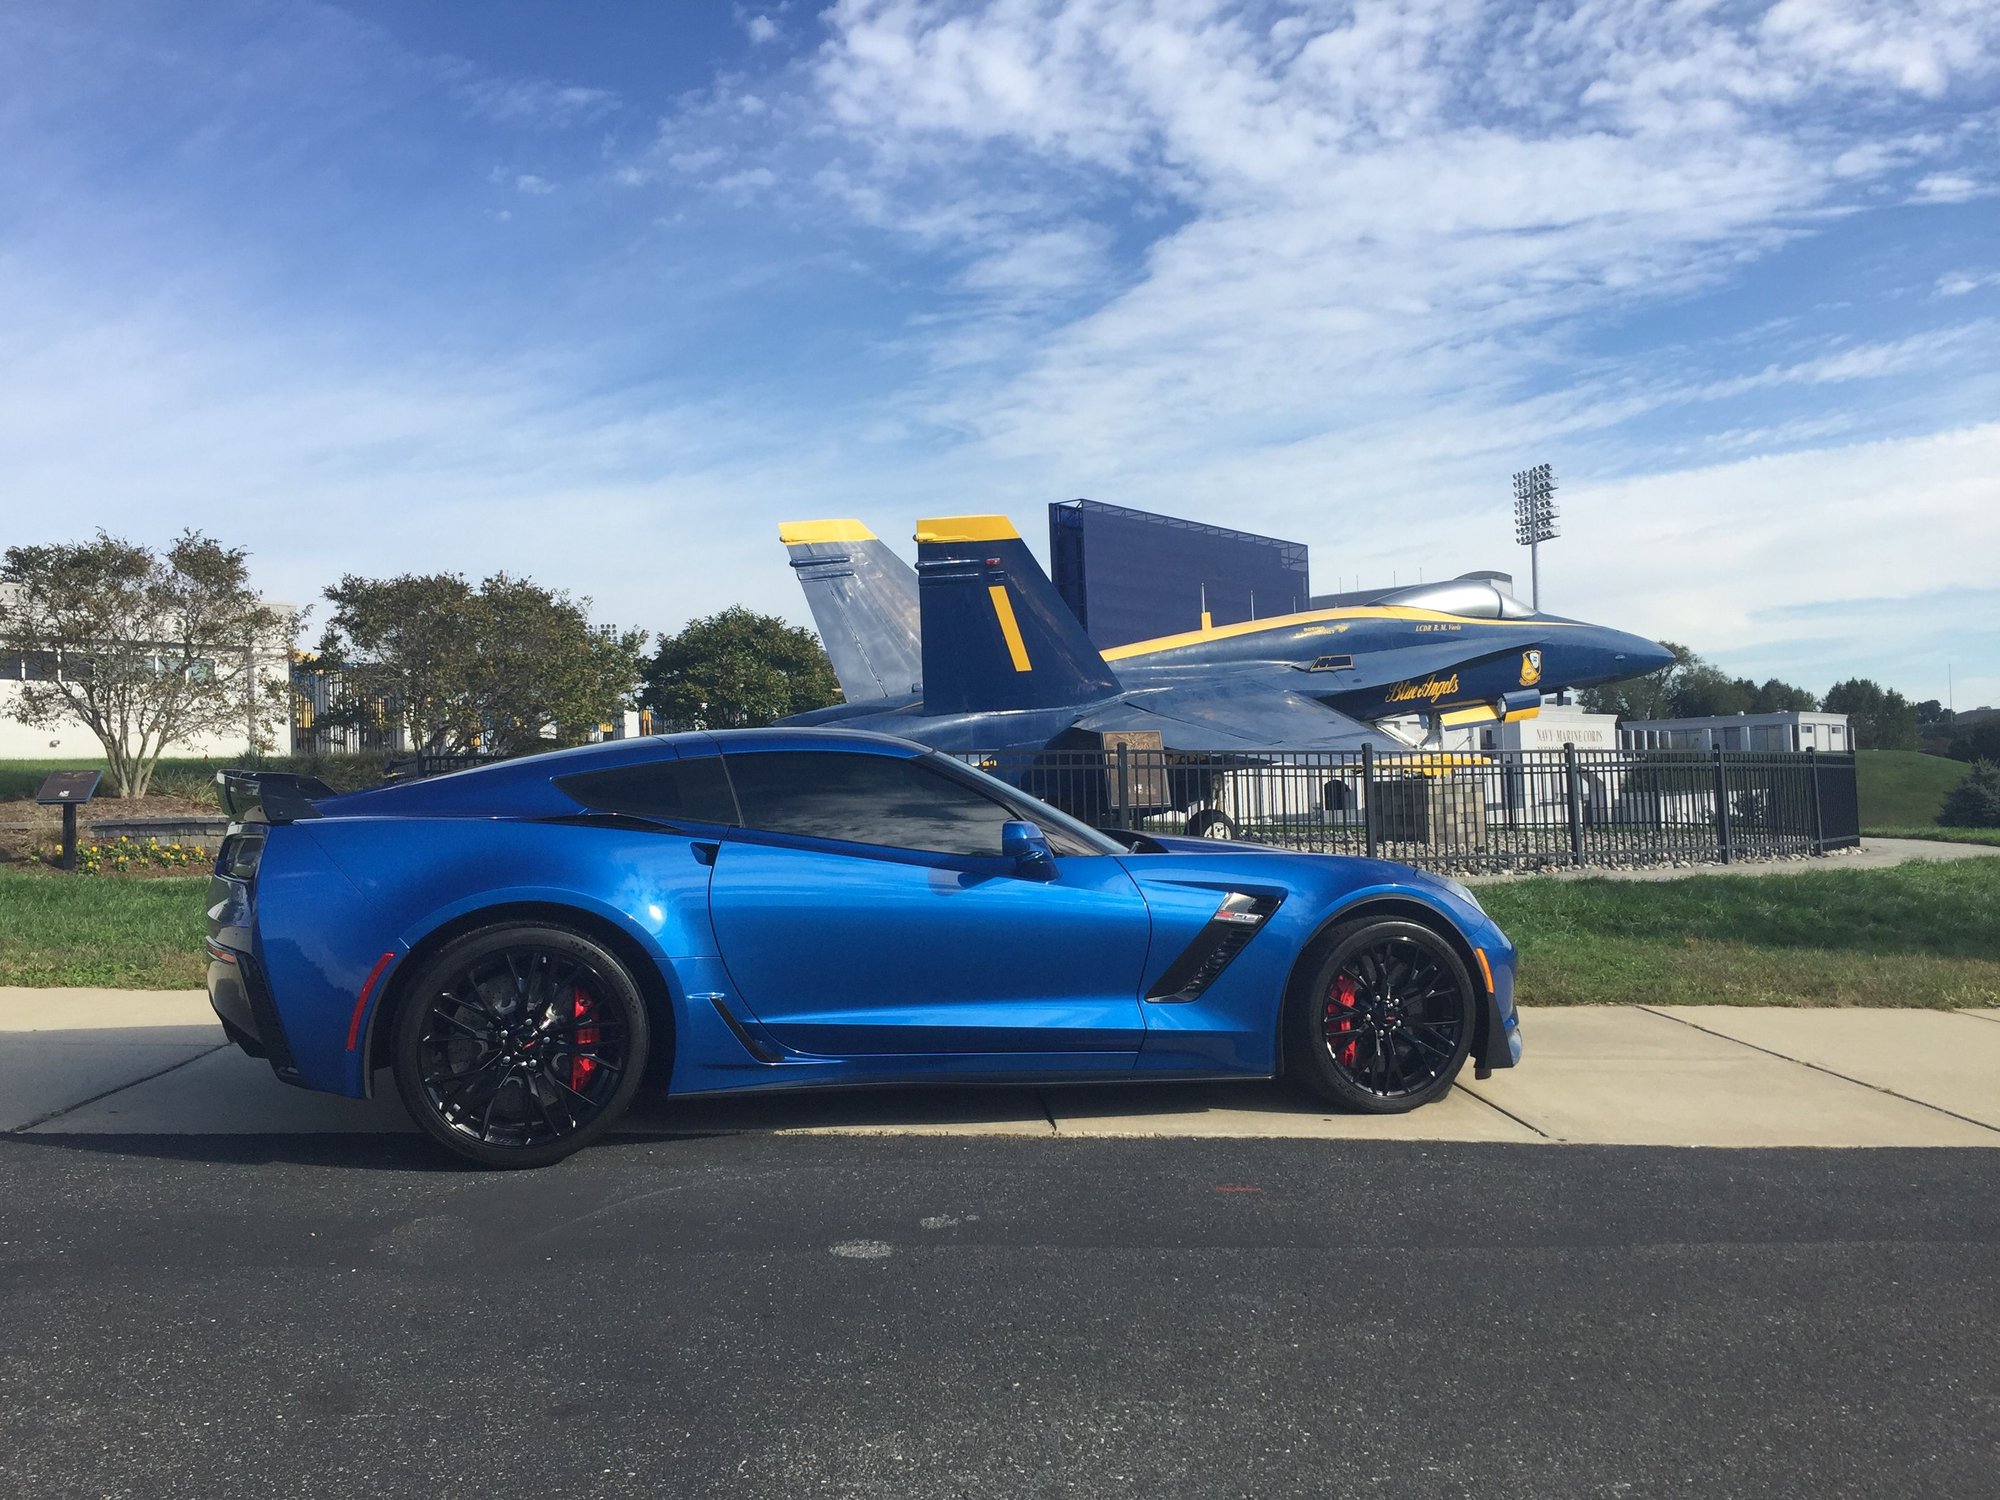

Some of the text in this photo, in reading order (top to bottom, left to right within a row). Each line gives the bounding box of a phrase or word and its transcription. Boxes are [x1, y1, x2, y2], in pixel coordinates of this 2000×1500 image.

[1385, 673, 1459, 704] Blue Angels
[1556, 729, 1582, 742] MARINE
[1583, 729, 1603, 743] CORPS
